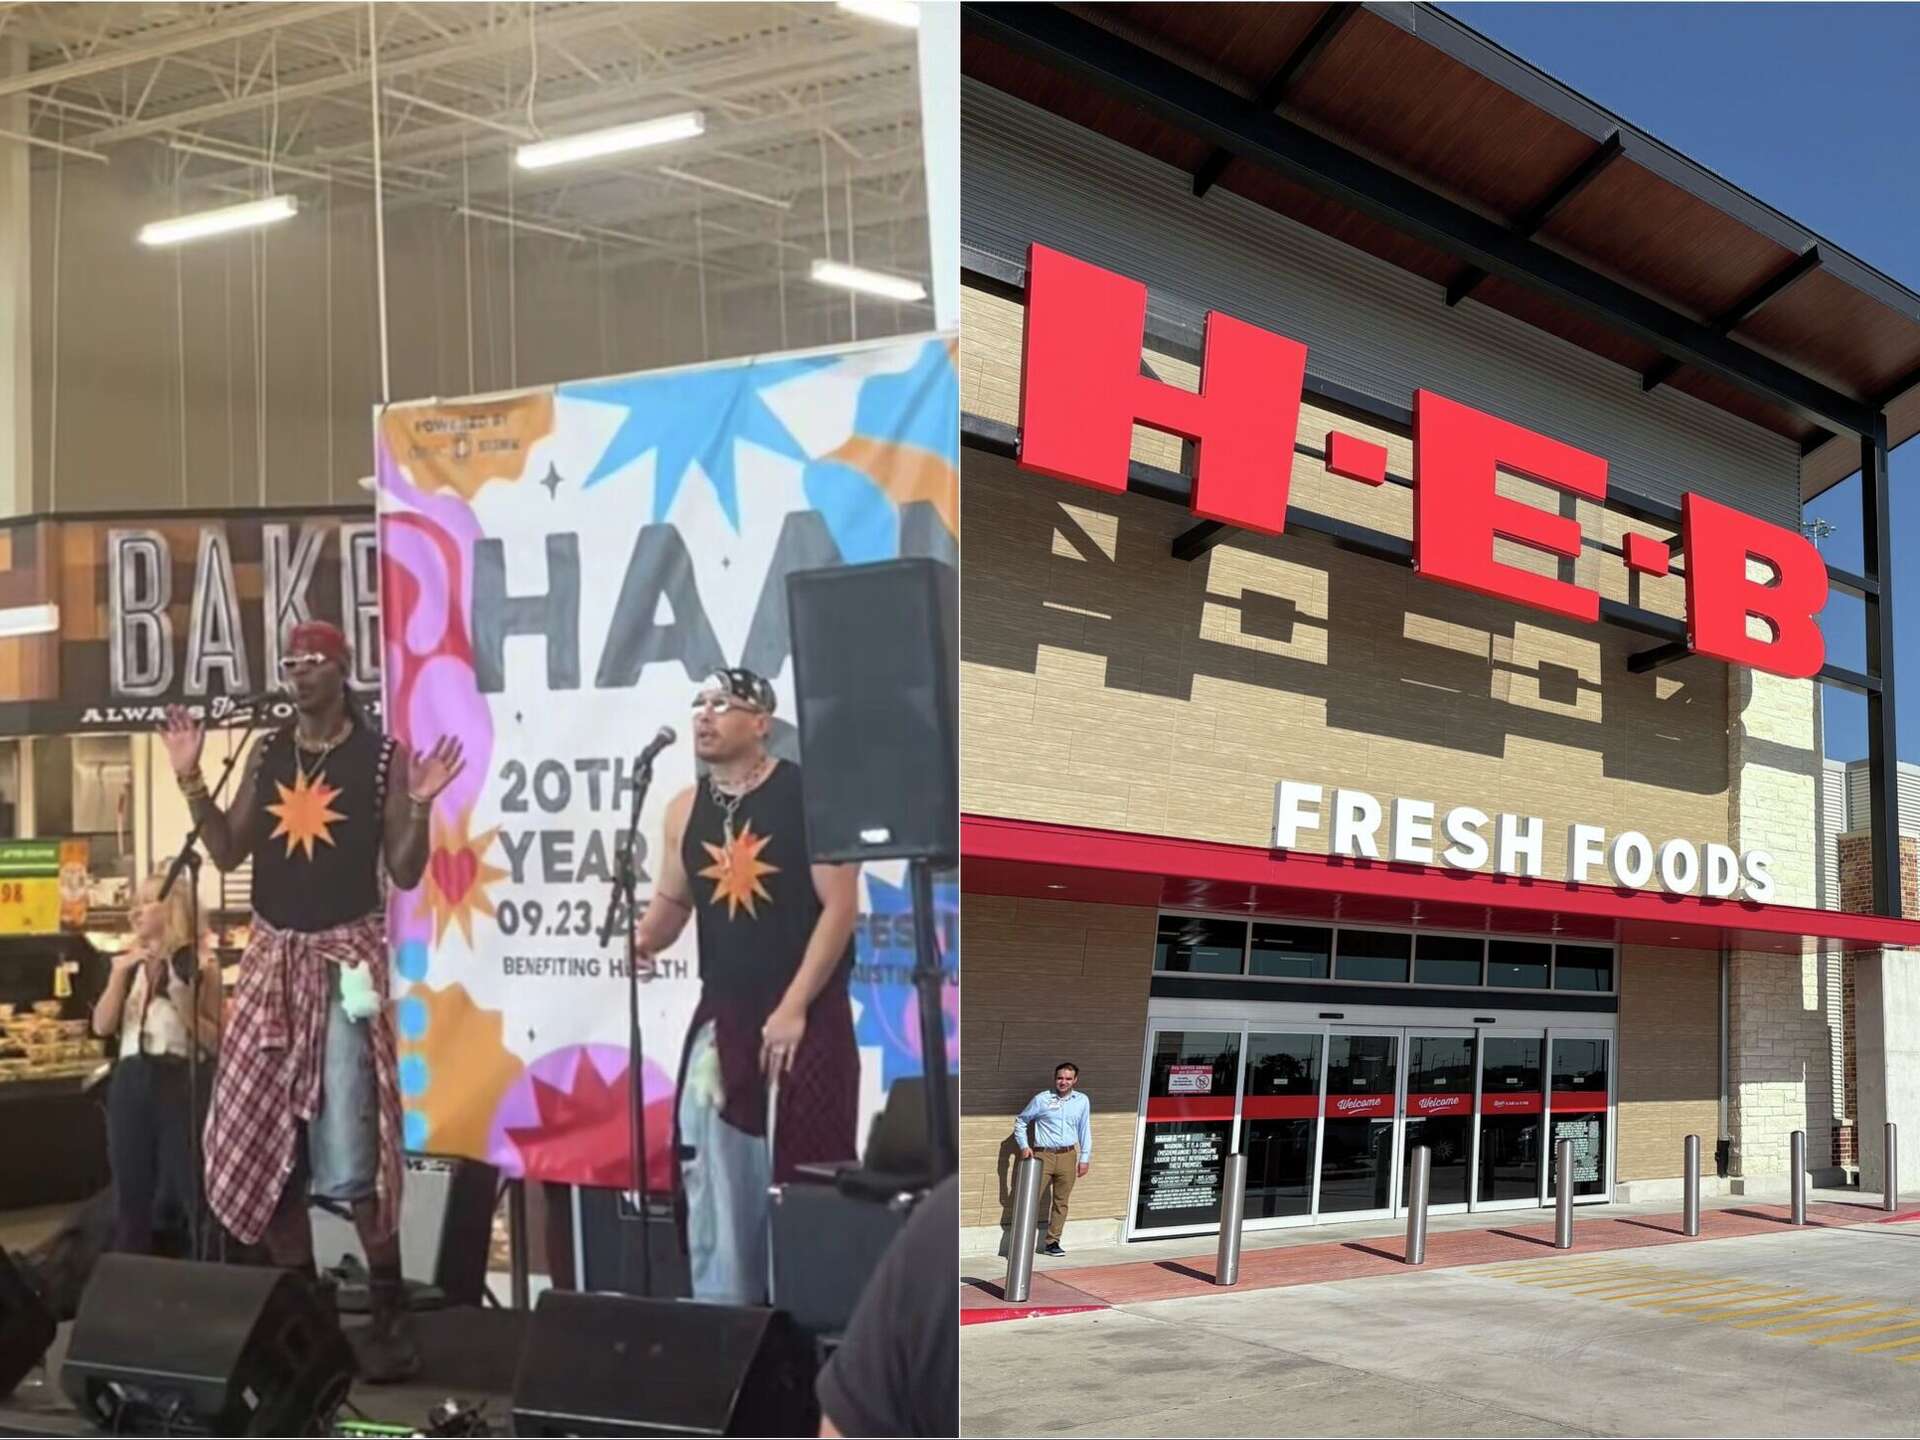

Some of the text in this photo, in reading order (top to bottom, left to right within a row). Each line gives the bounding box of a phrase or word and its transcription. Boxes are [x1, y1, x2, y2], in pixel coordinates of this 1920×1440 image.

[499, 757, 645, 813] 20TH
[497, 829, 652, 884] YEAR
[1273, 779, 1777, 903] FRESH FOODS
[503, 956, 600, 977] BENEFITING
[1337, 1097, 1382, 1110] Welcome
[1418, 1096, 1459, 1109] Welcome
